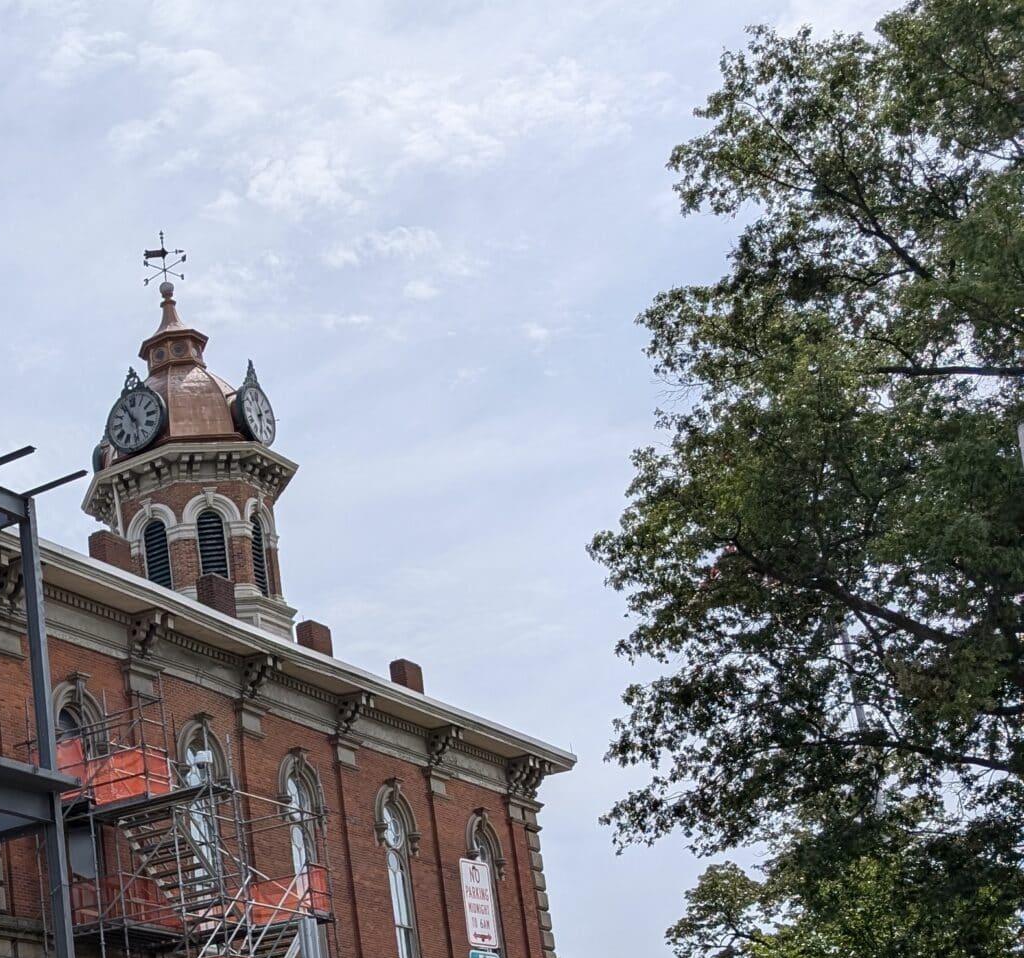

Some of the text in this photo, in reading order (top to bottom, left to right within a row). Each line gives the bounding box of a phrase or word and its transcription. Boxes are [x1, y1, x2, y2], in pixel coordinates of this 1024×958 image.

[469, 866, 481, 884] NO
[465, 885, 490, 901] PARKING
[468, 902, 490, 915] MIDNIGHT
[472, 916, 491, 930] TO 6AM
